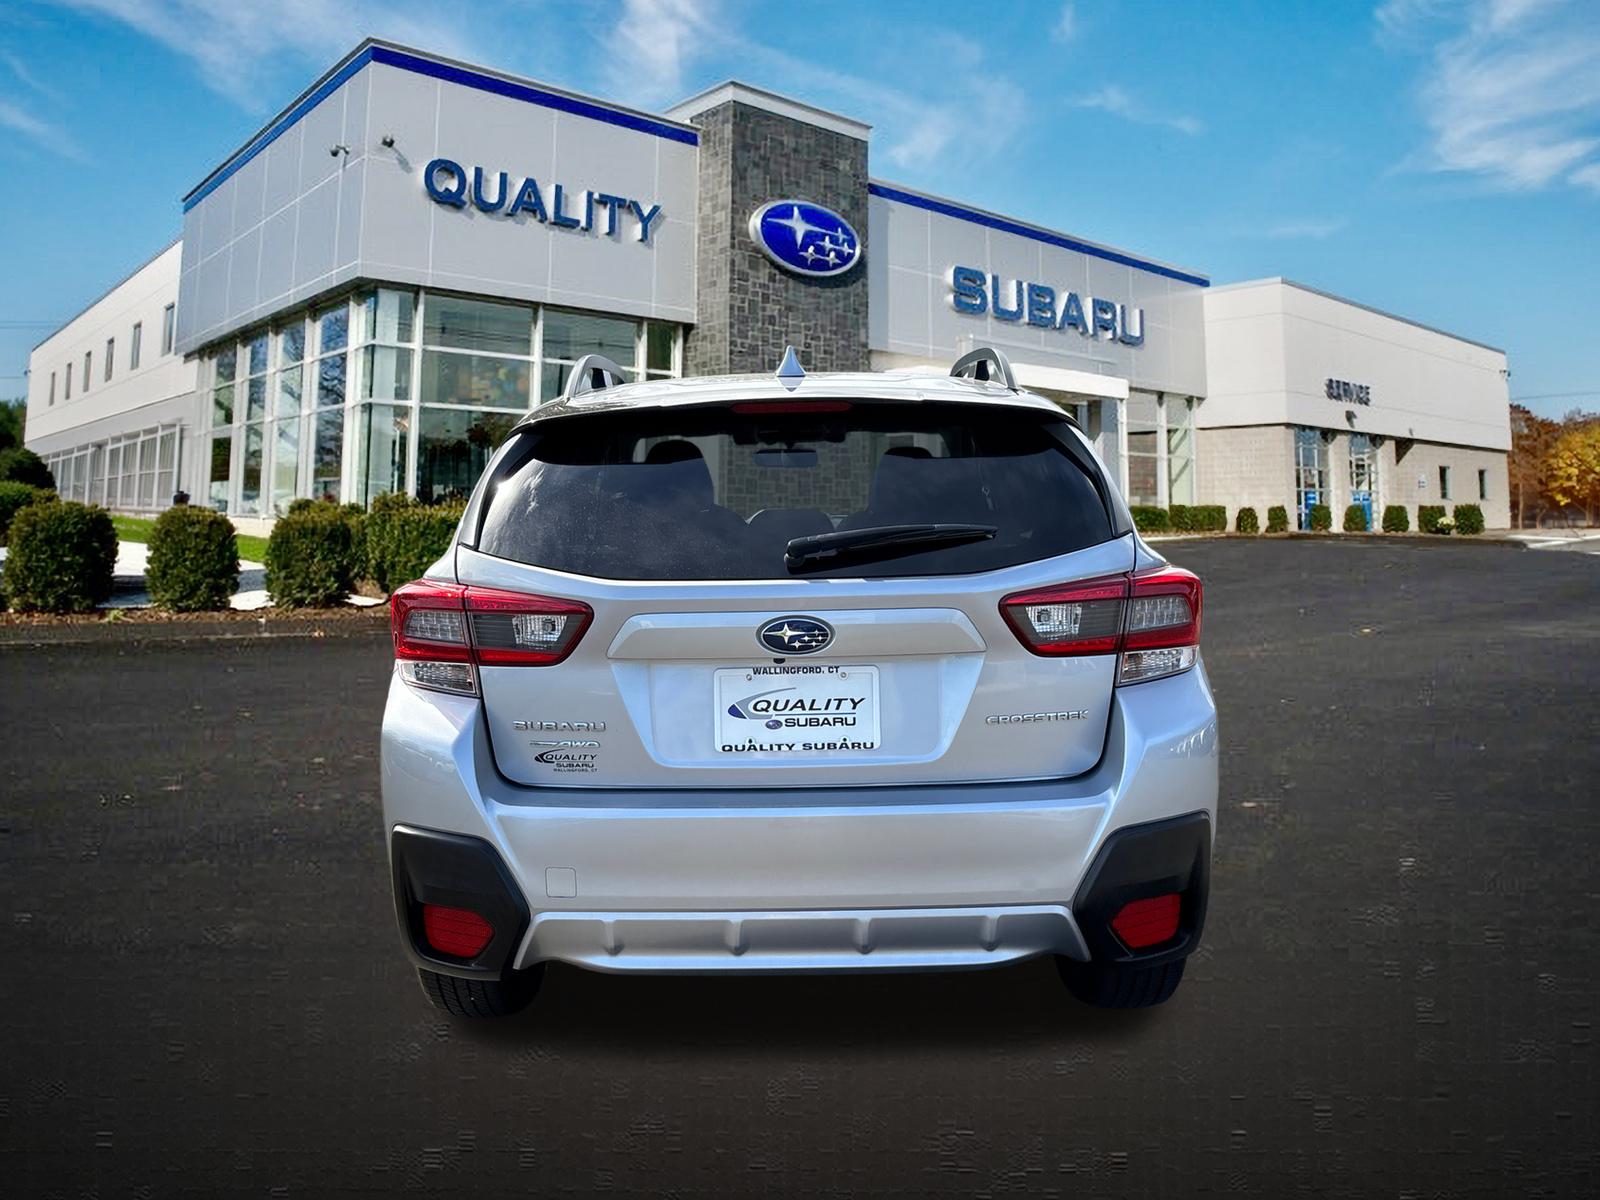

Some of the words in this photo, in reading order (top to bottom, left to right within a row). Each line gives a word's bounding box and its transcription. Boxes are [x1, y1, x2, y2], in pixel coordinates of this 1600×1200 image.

[423, 158, 661, 242] QUALITY
[948, 265, 1144, 346] SUBARU
[1325, 377, 1371, 406] SERVICE
[828, 666, 840, 674] CT
[752, 698, 866, 712] QUALITY
[784, 717, 857, 727] SUBARU
[985, 709, 1089, 724] CROSSTREK
[512, 720, 606, 732] SUBARU
[557, 740, 601, 748] AWD
[721, 742, 796, 752] QUALITY
[802, 741, 875, 751] SUBARU
[545, 753, 598, 761] QUALITY
